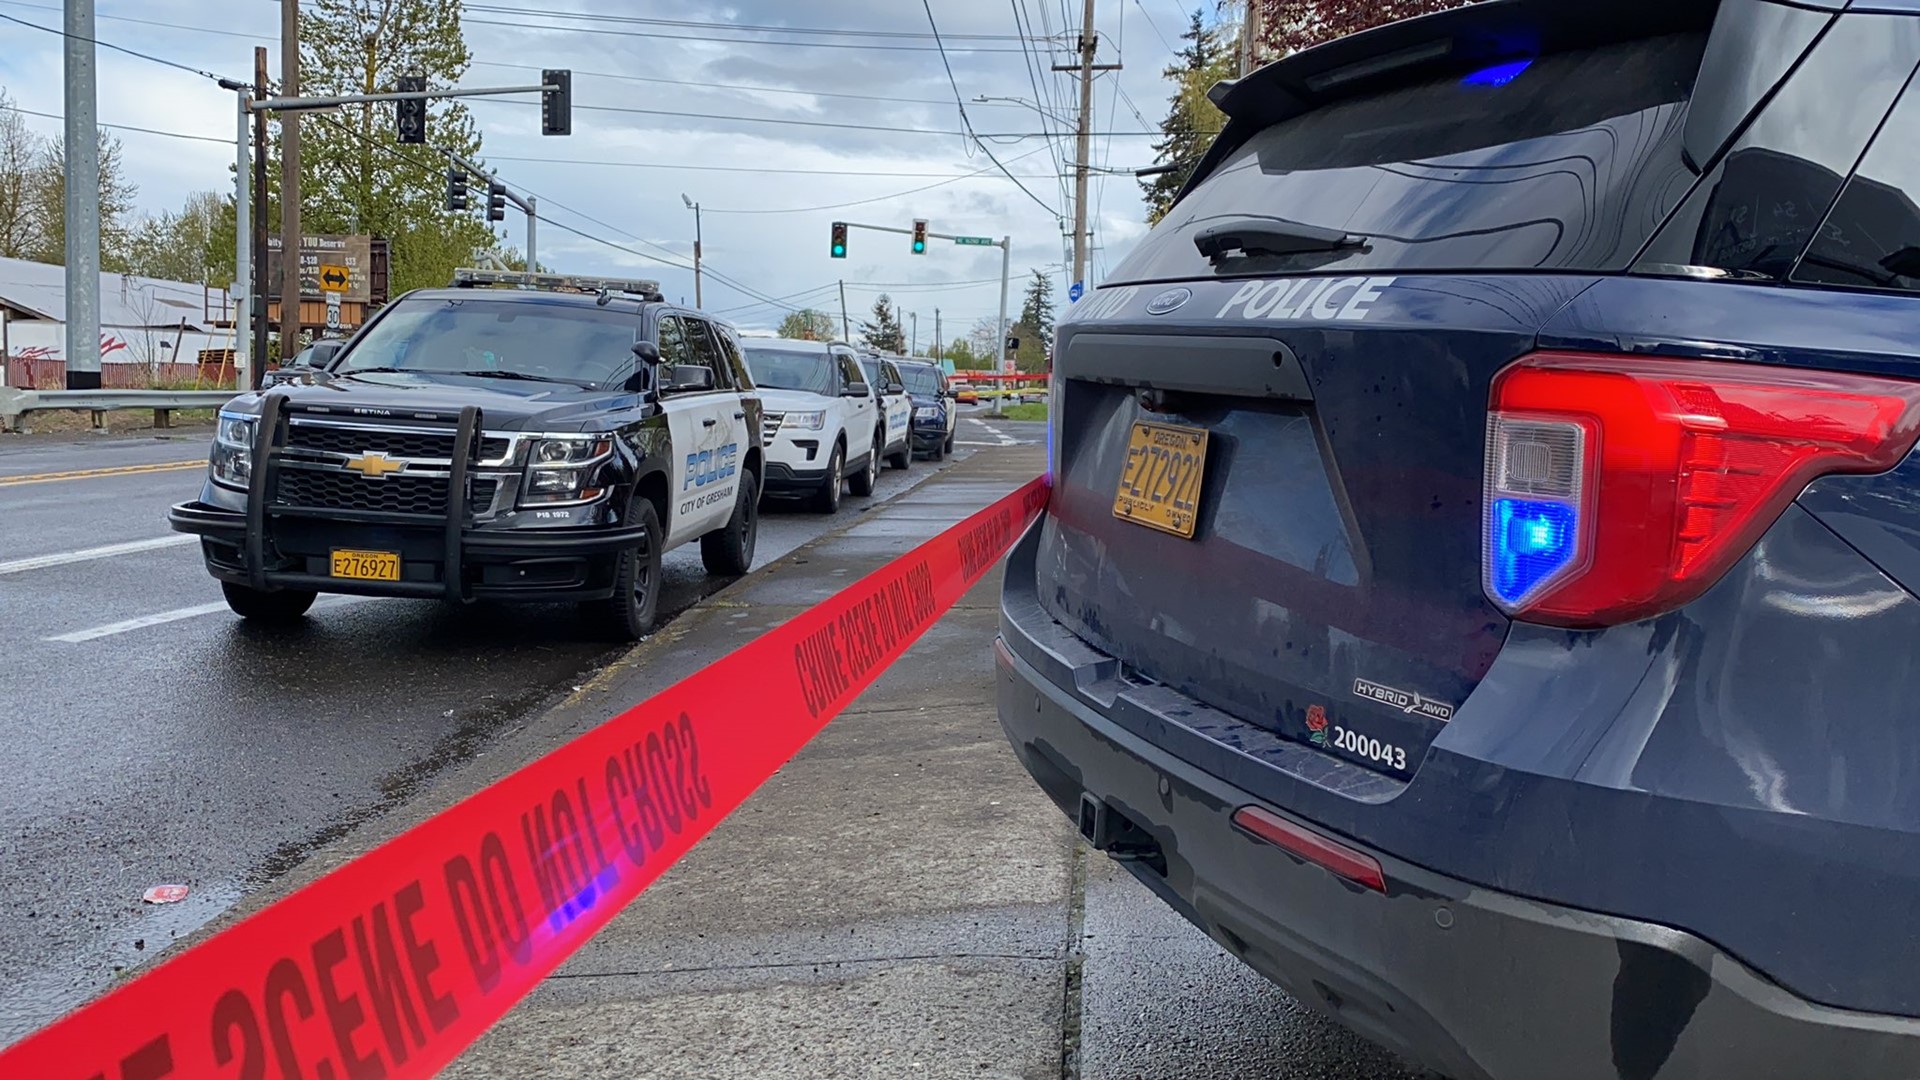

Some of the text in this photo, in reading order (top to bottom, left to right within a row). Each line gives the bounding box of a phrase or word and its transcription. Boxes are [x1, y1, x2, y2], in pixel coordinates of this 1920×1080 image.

[303, 237, 318, 247] YOU
[1215, 277, 1398, 320] POLICE
[328, 309, 338, 324] 30
[1154, 431, 1188, 450] OREGON
[684, 443, 737, 491] POLICE
[680, 486, 733, 515] CITY OF GRESHAM
[335, 558, 396, 578] E276927
[1357, 682, 1450, 718] HYBRID AWD
[1334, 726, 1406, 770] 200043
